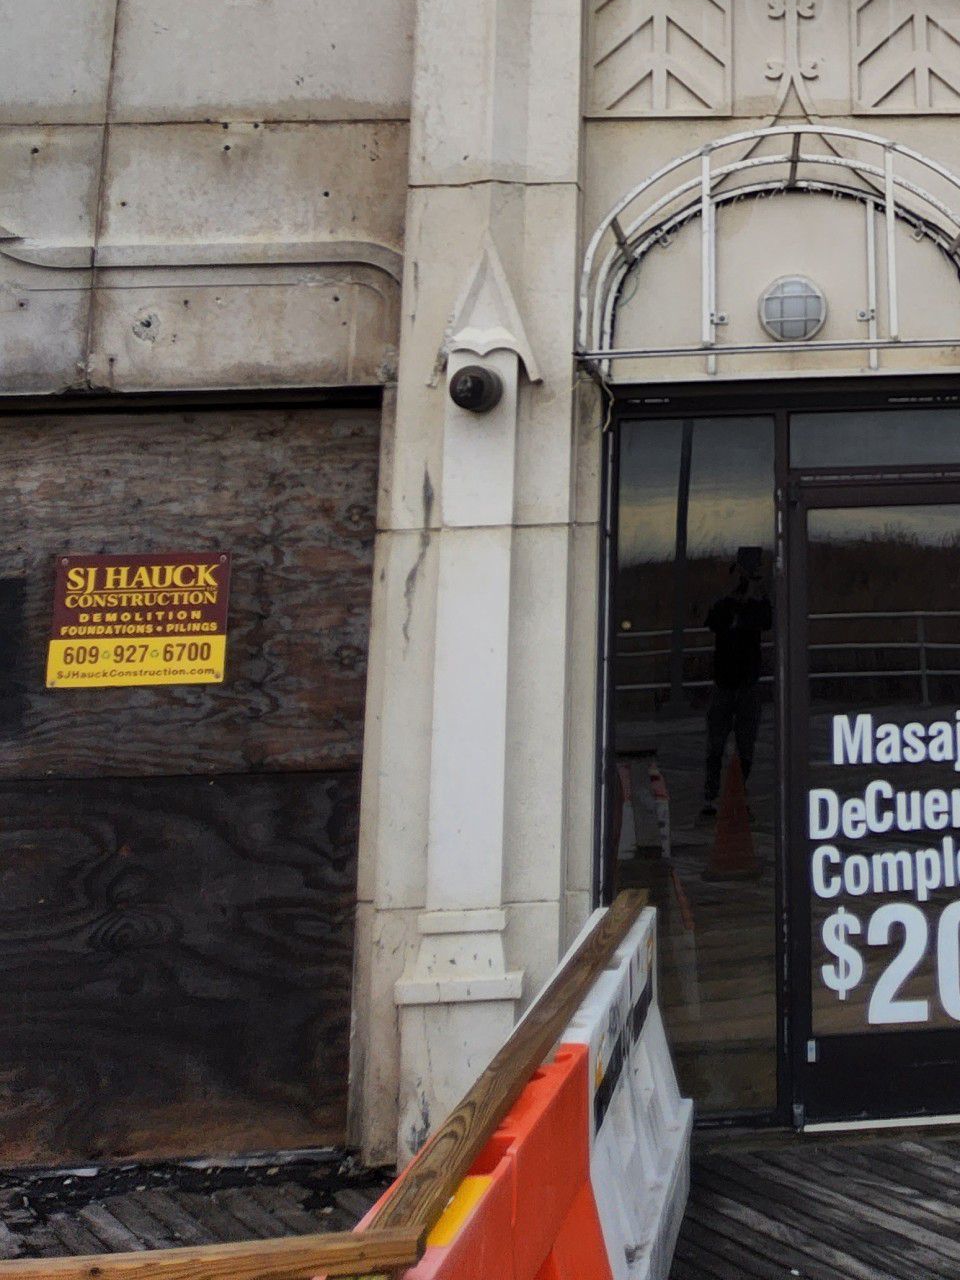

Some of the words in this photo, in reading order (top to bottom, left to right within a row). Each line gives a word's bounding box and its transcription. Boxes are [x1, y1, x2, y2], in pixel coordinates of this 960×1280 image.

[66, 566, 98, 594] SJ
[104, 563, 220, 589] HAUCK
[64, 591, 218, 608] CONSTRUCTION
[79, 610, 202, 623] DEMOLITION
[60, 624, 153, 636] FOUNDATIONS
[166, 622, 218, 632] PILINGS
[63, 645, 100, 665] 609
[113, 644, 149, 664] 927
[162, 642, 212, 662] 6700
[56, 667, 216, 680] SJHauckConstruction.com
